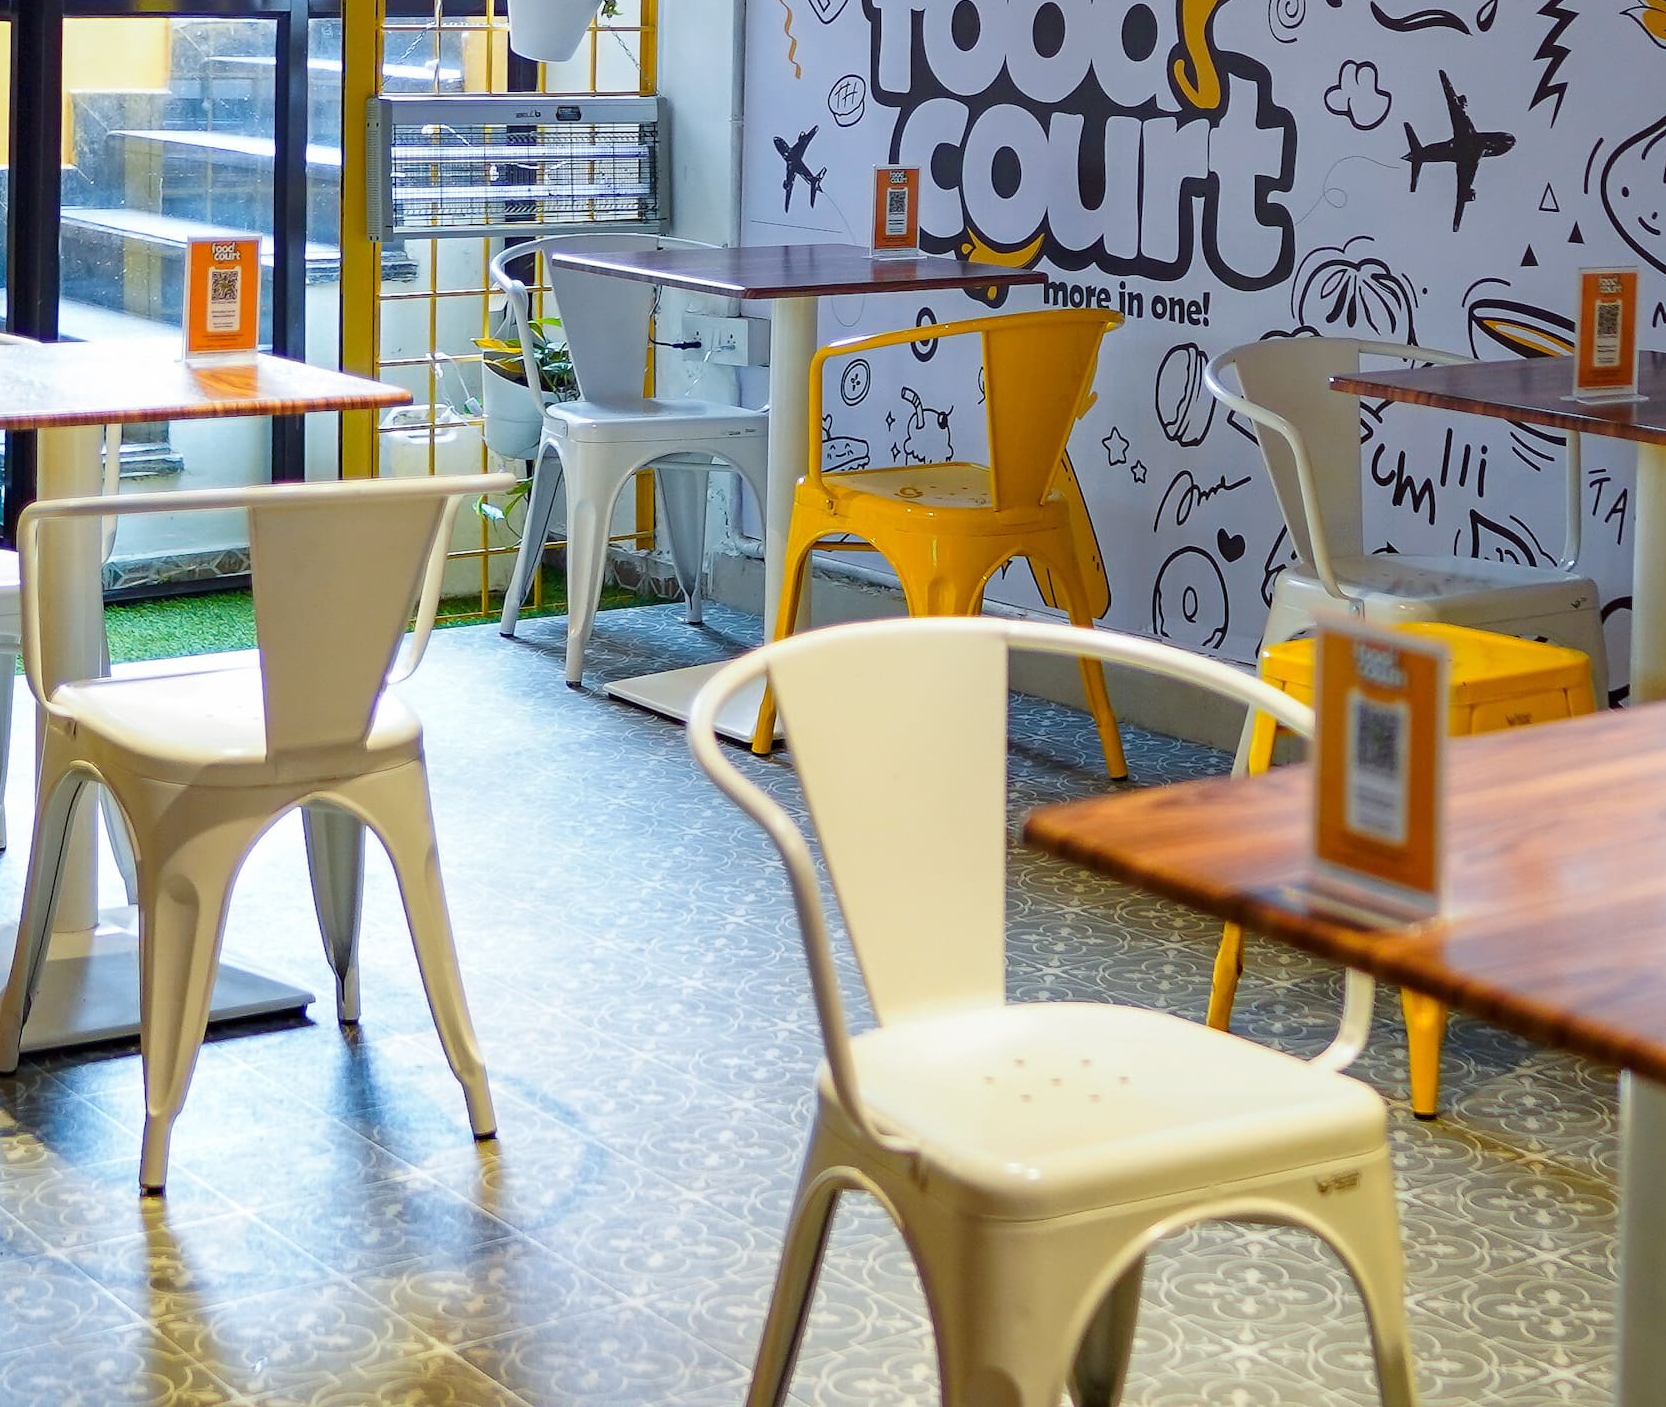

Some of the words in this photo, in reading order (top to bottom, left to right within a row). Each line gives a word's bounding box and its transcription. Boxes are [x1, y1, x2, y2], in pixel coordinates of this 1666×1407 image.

[891, 60, 1297, 288] court
[1043, 281, 1112, 309] more
[1118, 280, 1144, 319] in
[1151, 292, 1211, 327] one!
